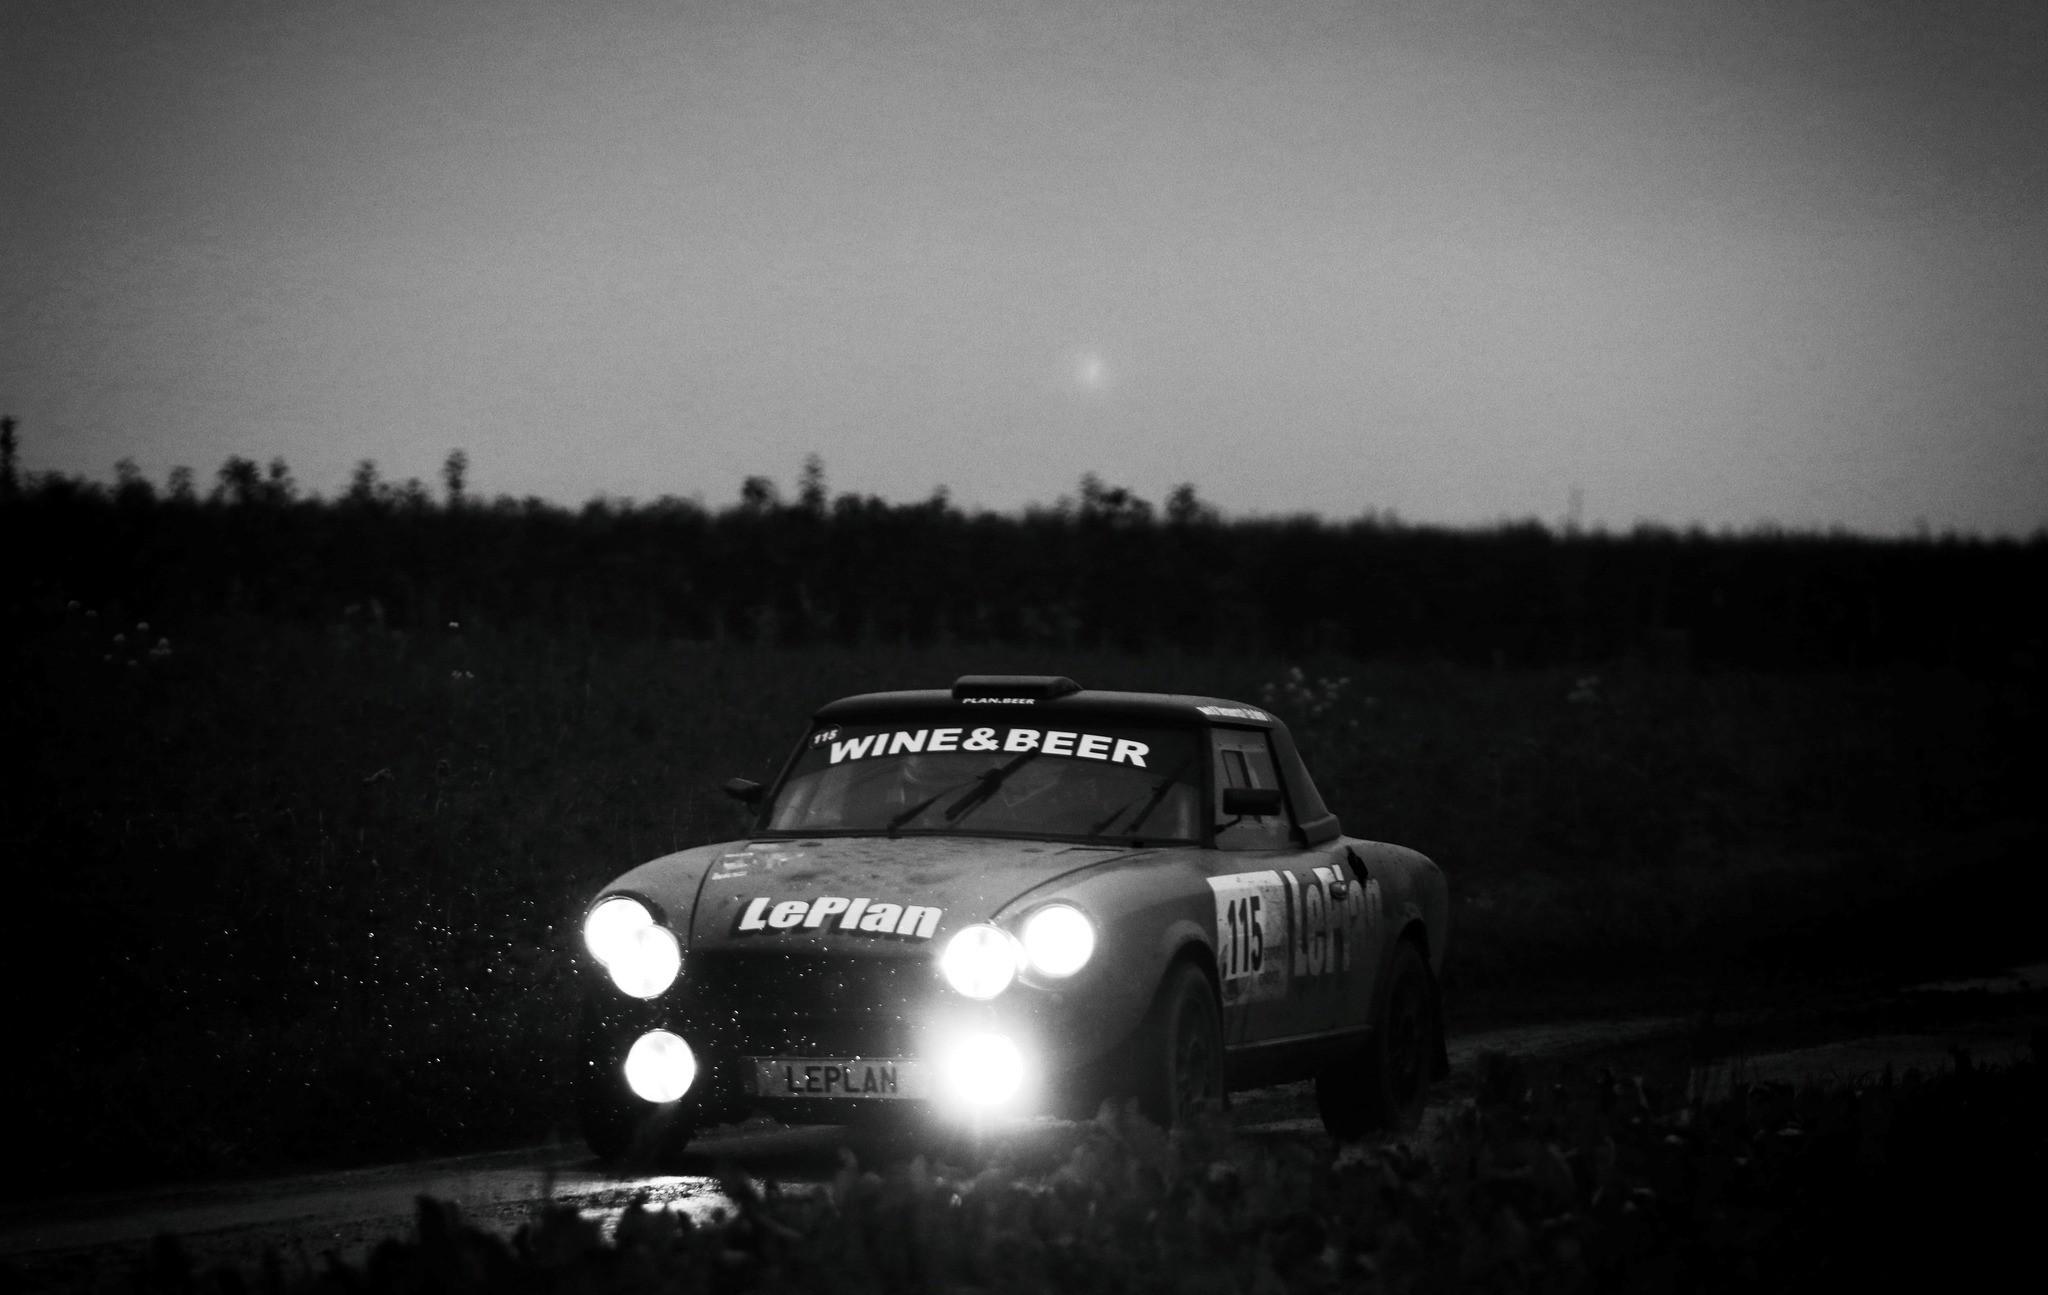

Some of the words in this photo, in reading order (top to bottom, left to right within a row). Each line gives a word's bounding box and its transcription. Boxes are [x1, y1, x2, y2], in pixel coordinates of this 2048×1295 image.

[962, 697, 1036, 705] PLAN.BEER
[813, 729, 839, 745] 115
[828, 727, 1150, 767] WINE&BEER
[738, 896, 943, 938] LePlan
[1227, 895, 1264, 975] 115
[786, 1065, 897, 1093] LEPLAN
